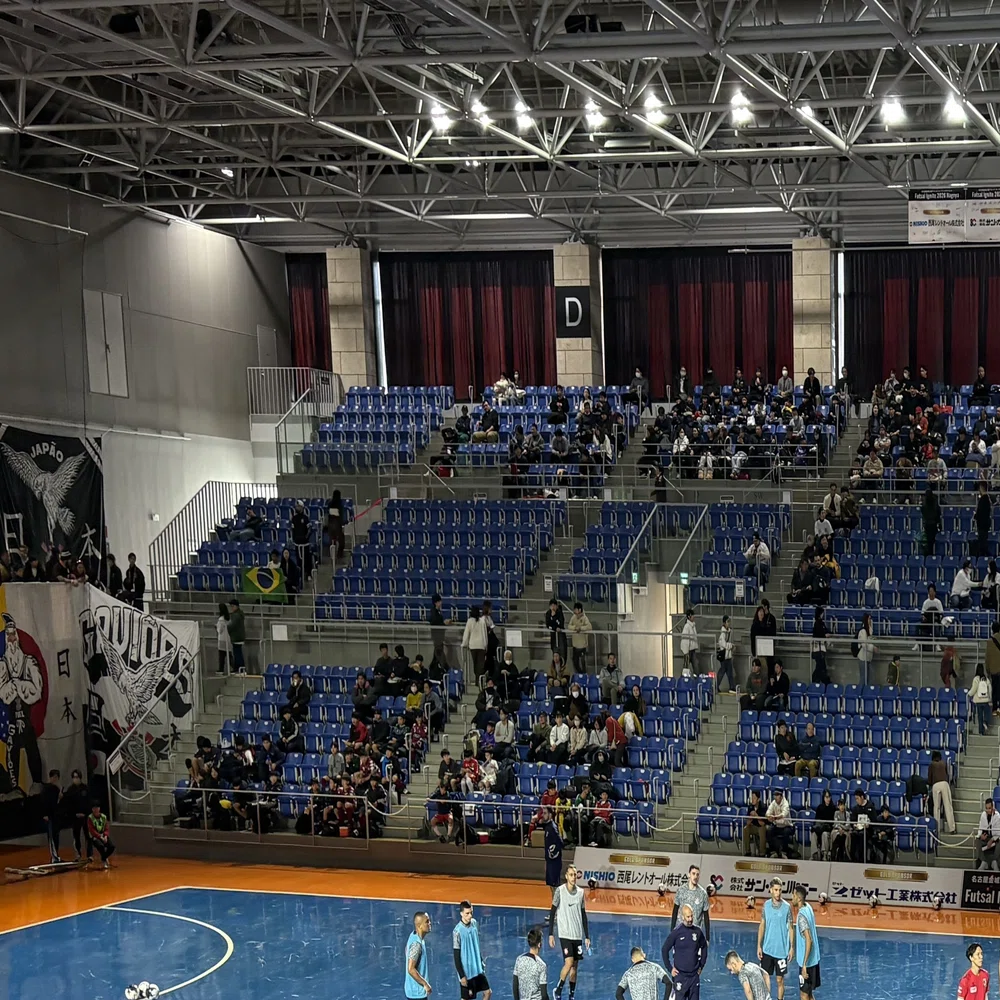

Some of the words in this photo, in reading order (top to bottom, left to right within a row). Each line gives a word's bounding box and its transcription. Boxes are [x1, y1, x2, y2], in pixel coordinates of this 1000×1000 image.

[565, 297, 582, 327] D
[30, 441, 64, 462] JAPÃO
[584, 870, 615, 881] NISHIO
[617, 870, 688, 887] 西尾レントオール株式会
[850, 886, 957, 904] ゼット工業株式会社
[965, 889, 994, 903] Futsal
